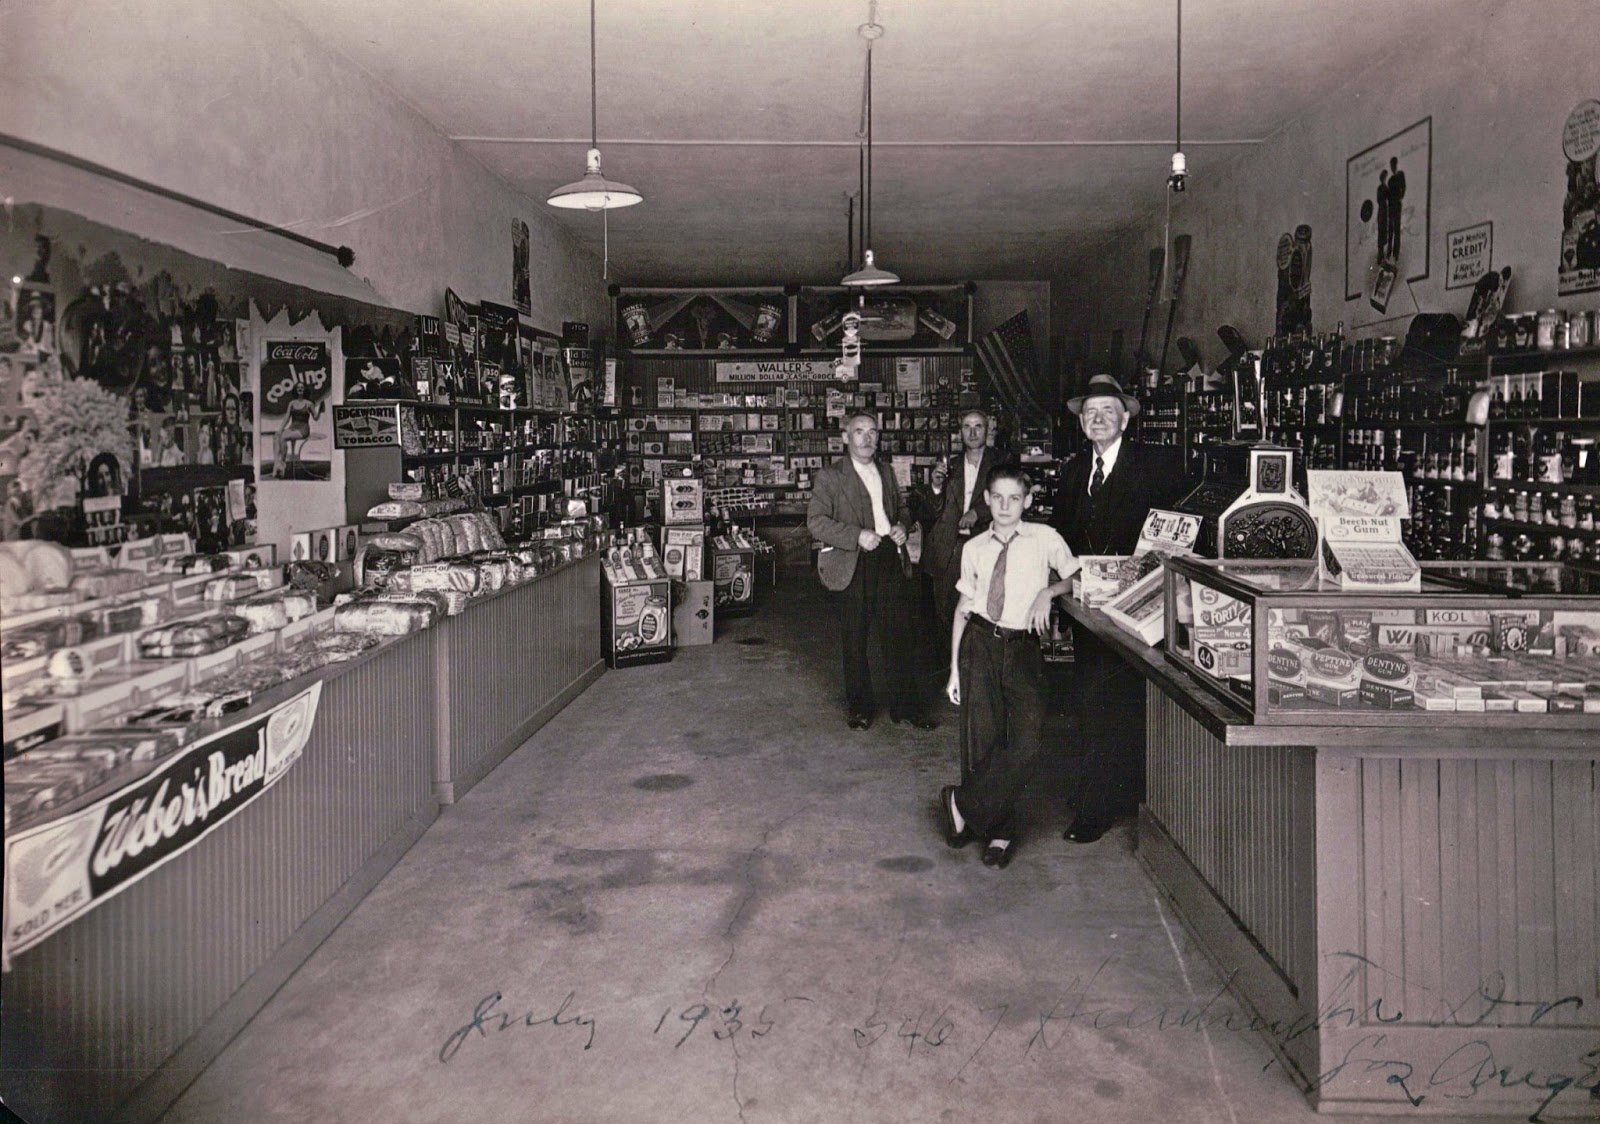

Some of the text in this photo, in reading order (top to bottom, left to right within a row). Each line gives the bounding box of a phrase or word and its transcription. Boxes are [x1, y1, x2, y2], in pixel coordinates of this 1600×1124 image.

[422, 316, 440, 336] LUX
[271, 344, 319, 361] Coca-Cola
[757, 362, 812, 374] WALLER'S
[266, 363, 327, 404] cooling
[729, 373, 756, 381] MILLION
[337, 406, 396, 421] EDGEWORTH
[343, 435, 393, 445] TOBACCO
[1353, 525, 1379, 534] Gum
[1211, 601, 1238, 625] FORTY
[1433, 611, 1468, 623] KOOL
[1224, 629, 1241, 638] New
[1267, 653, 1299, 669] DENTYNE
[1367, 656, 1408, 674] DENTYNE
[1377, 667, 1393, 676] GUM
[92, 726, 267, 878] Weber's Bread
[12, 908, 50, 942] SOLD
